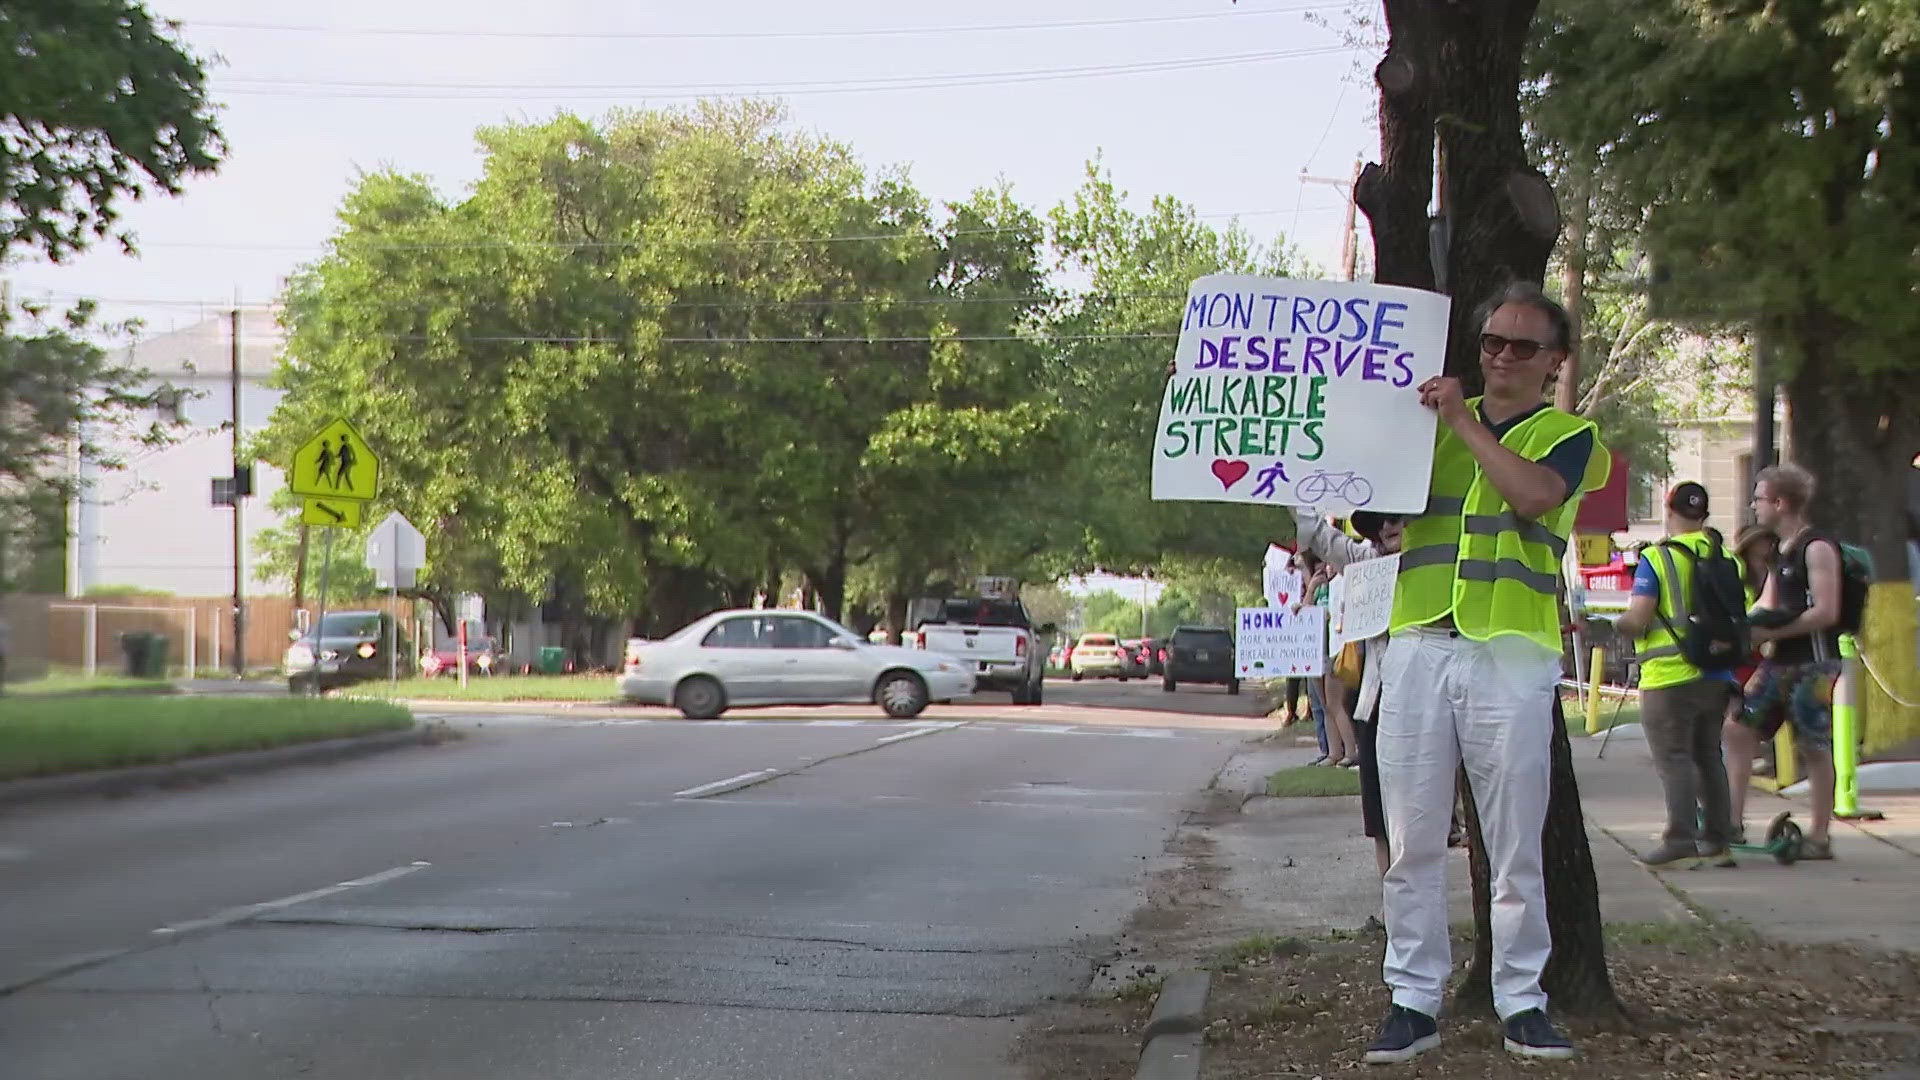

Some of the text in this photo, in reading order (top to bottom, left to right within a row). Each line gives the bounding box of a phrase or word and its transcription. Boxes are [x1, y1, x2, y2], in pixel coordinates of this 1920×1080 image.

[1184, 293, 1408, 349] MONTROSE
[1195, 336, 1414, 388] DESERVES
[1169, 375, 1328, 420] WALKABLE
[1163, 417, 1324, 461] STREETS
[1242, 612, 1284, 630] HONK
[1308, 614, 1314, 626] A
